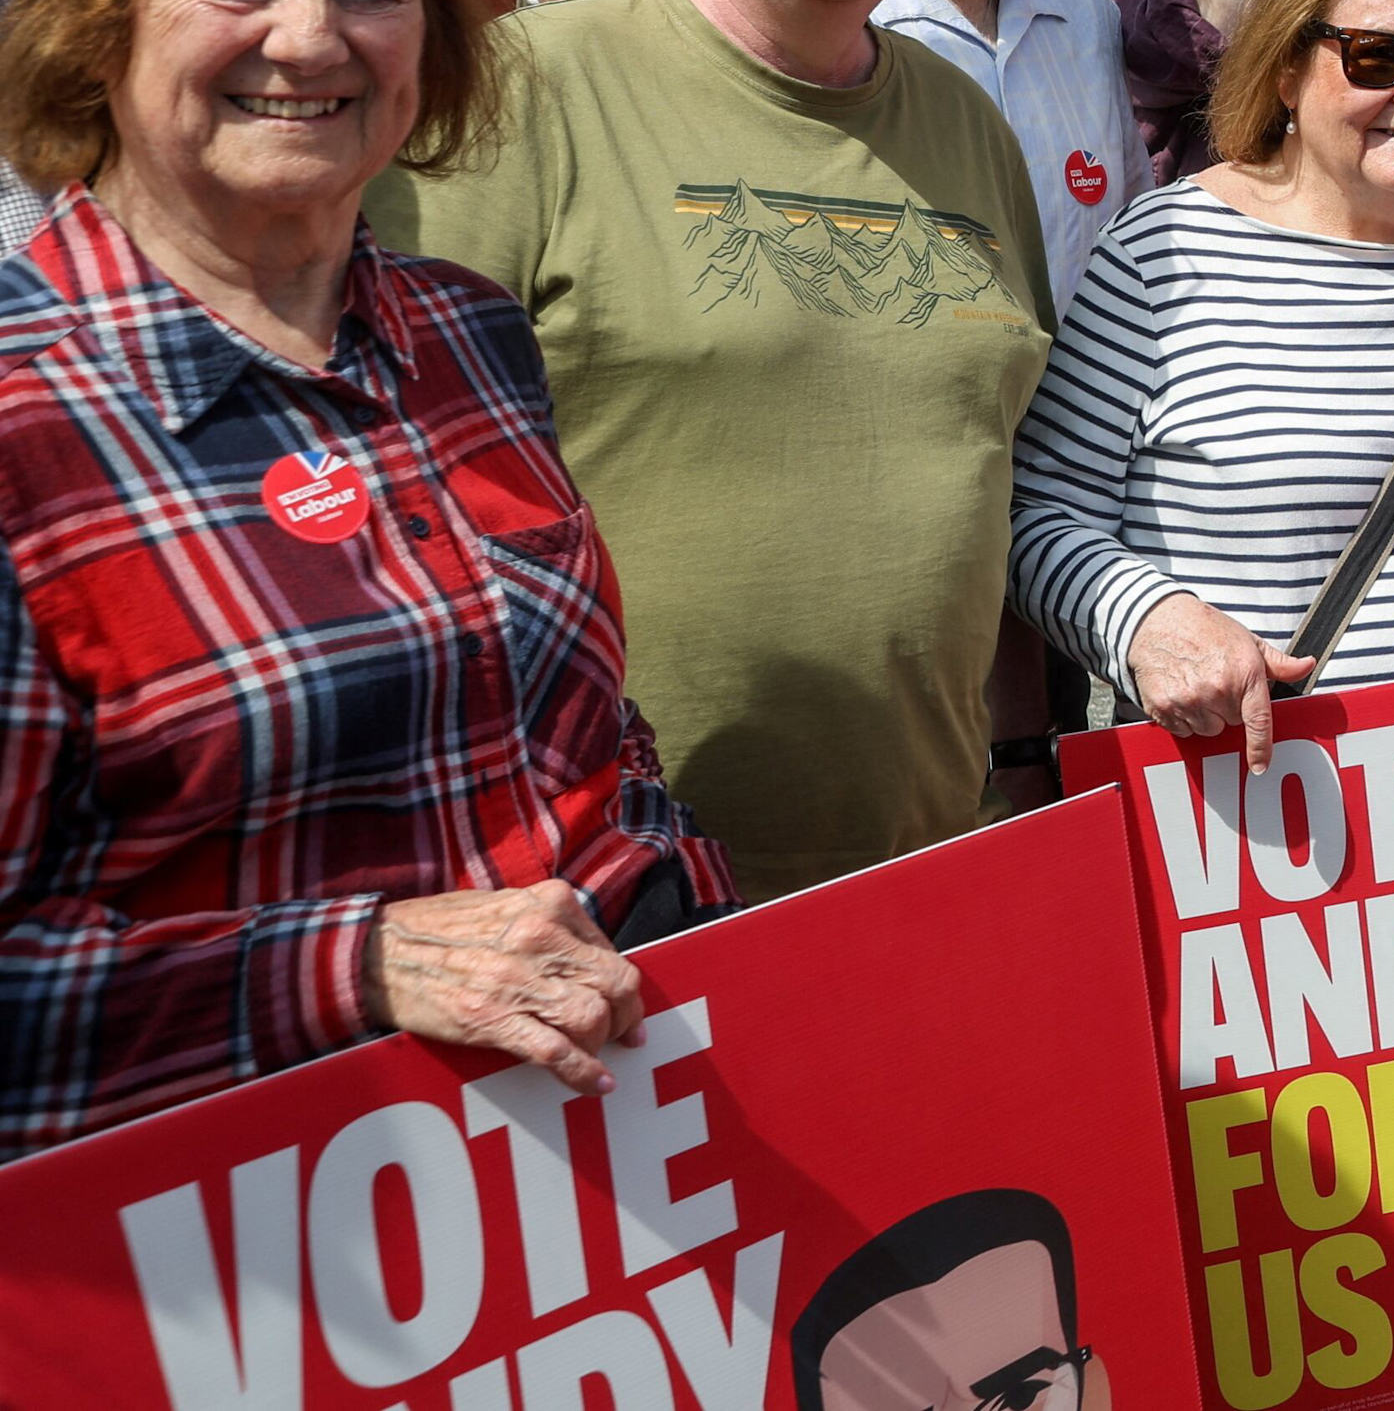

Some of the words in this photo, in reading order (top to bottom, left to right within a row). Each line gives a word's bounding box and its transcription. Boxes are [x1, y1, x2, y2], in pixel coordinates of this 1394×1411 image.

[1072, 177, 1102, 188] Labour
[285, 487, 357, 522] Labour
[119, 997, 740, 1411] VOTE
[1204, 1232, 1394, 1410] US
